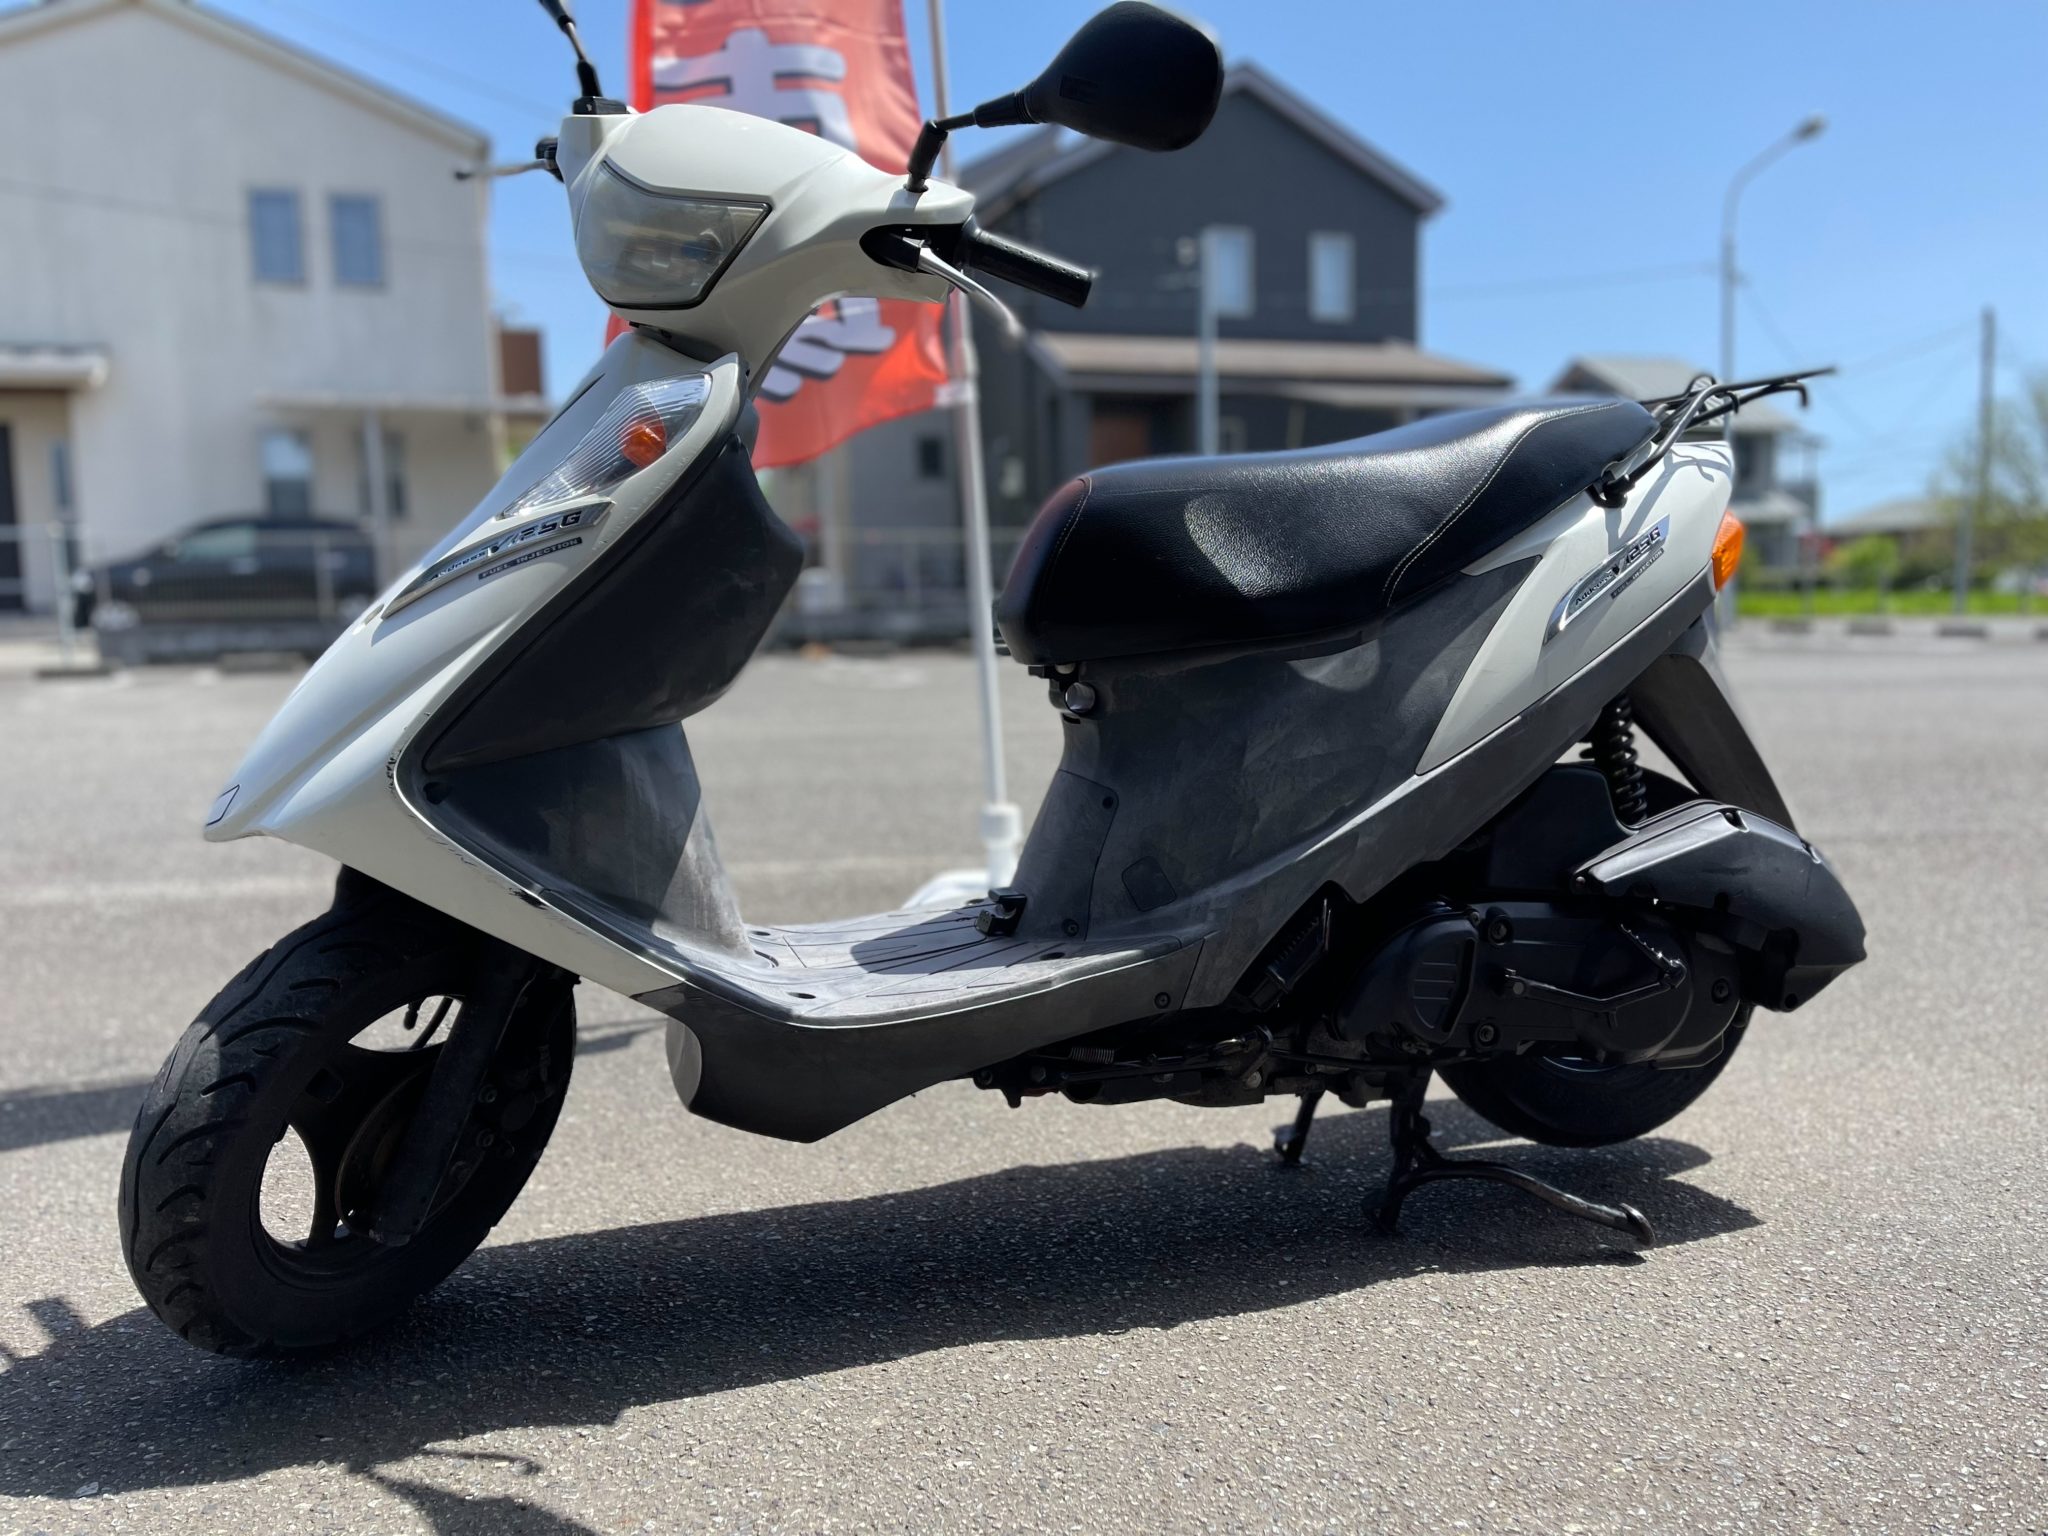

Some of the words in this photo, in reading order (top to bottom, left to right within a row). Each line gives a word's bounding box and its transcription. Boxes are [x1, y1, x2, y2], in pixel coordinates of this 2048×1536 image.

[482, 561, 510, 578] FUEL
[516, 537, 579, 564] INJECTION
[1611, 526, 1661, 577] V125G
[1632, 550, 1662, 580] INJECTION
